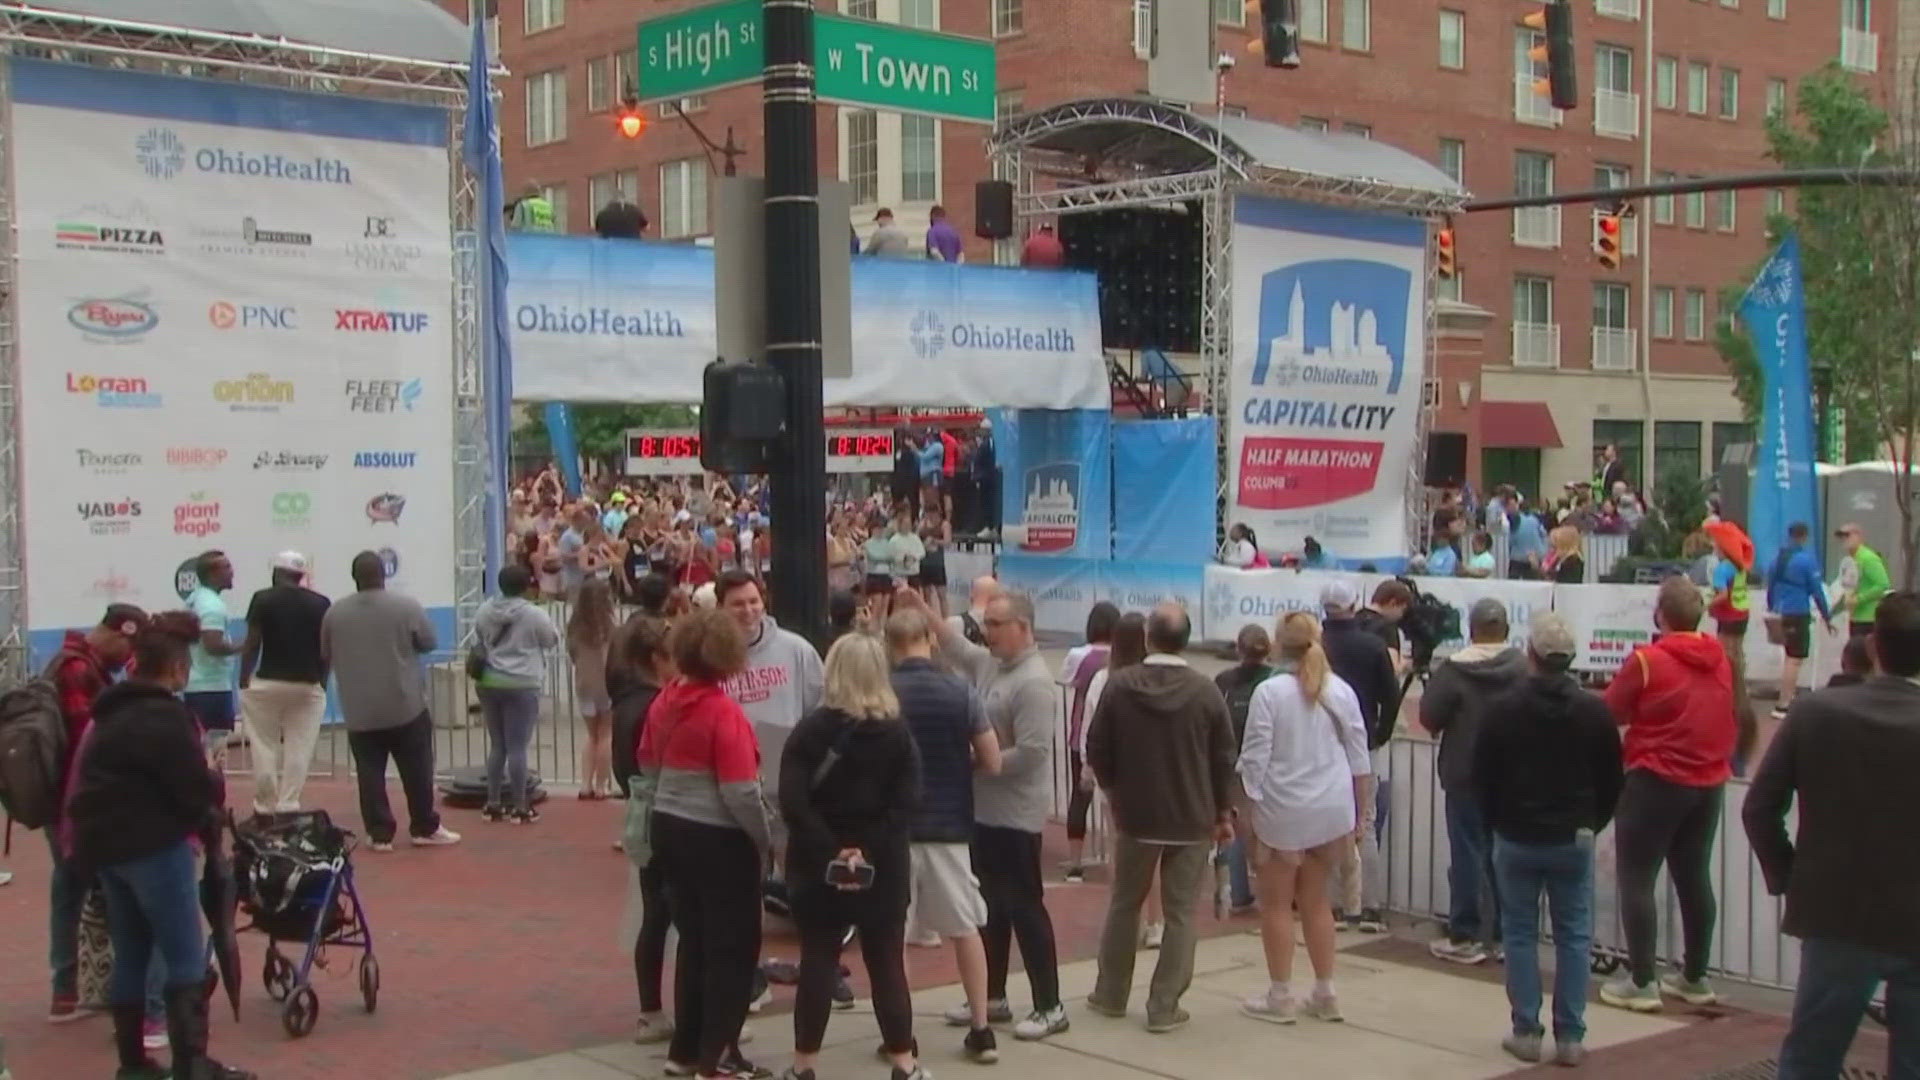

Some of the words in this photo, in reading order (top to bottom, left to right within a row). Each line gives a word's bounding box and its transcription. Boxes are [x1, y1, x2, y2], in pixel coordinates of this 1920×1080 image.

[649, 47, 657, 66] S
[665, 20, 731, 76] High
[740, 21, 756, 45] St
[828, 48, 842, 72] W
[855, 43, 951, 95] Town
[962, 69, 978, 92] St
[195, 147, 352, 185] OhioHealth
[100, 227, 164, 246] PIZZA
[242, 306, 298, 330] PNC
[335, 309, 429, 333] XTRATUF
[516, 304, 684, 338] OhioHealth
[951, 323, 1076, 353] OhioHealth
[345, 379, 403, 397] FLEET
[1302, 365, 1379, 388] OhioHealth
[350, 396, 401, 413] FEET
[353, 451, 416, 469] ABSOLUT
[1246, 448, 1281, 466] HALF
[1284, 449, 1373, 470] MARATHON
[174, 503, 221, 521] giant
[174, 521, 222, 538] eagle
